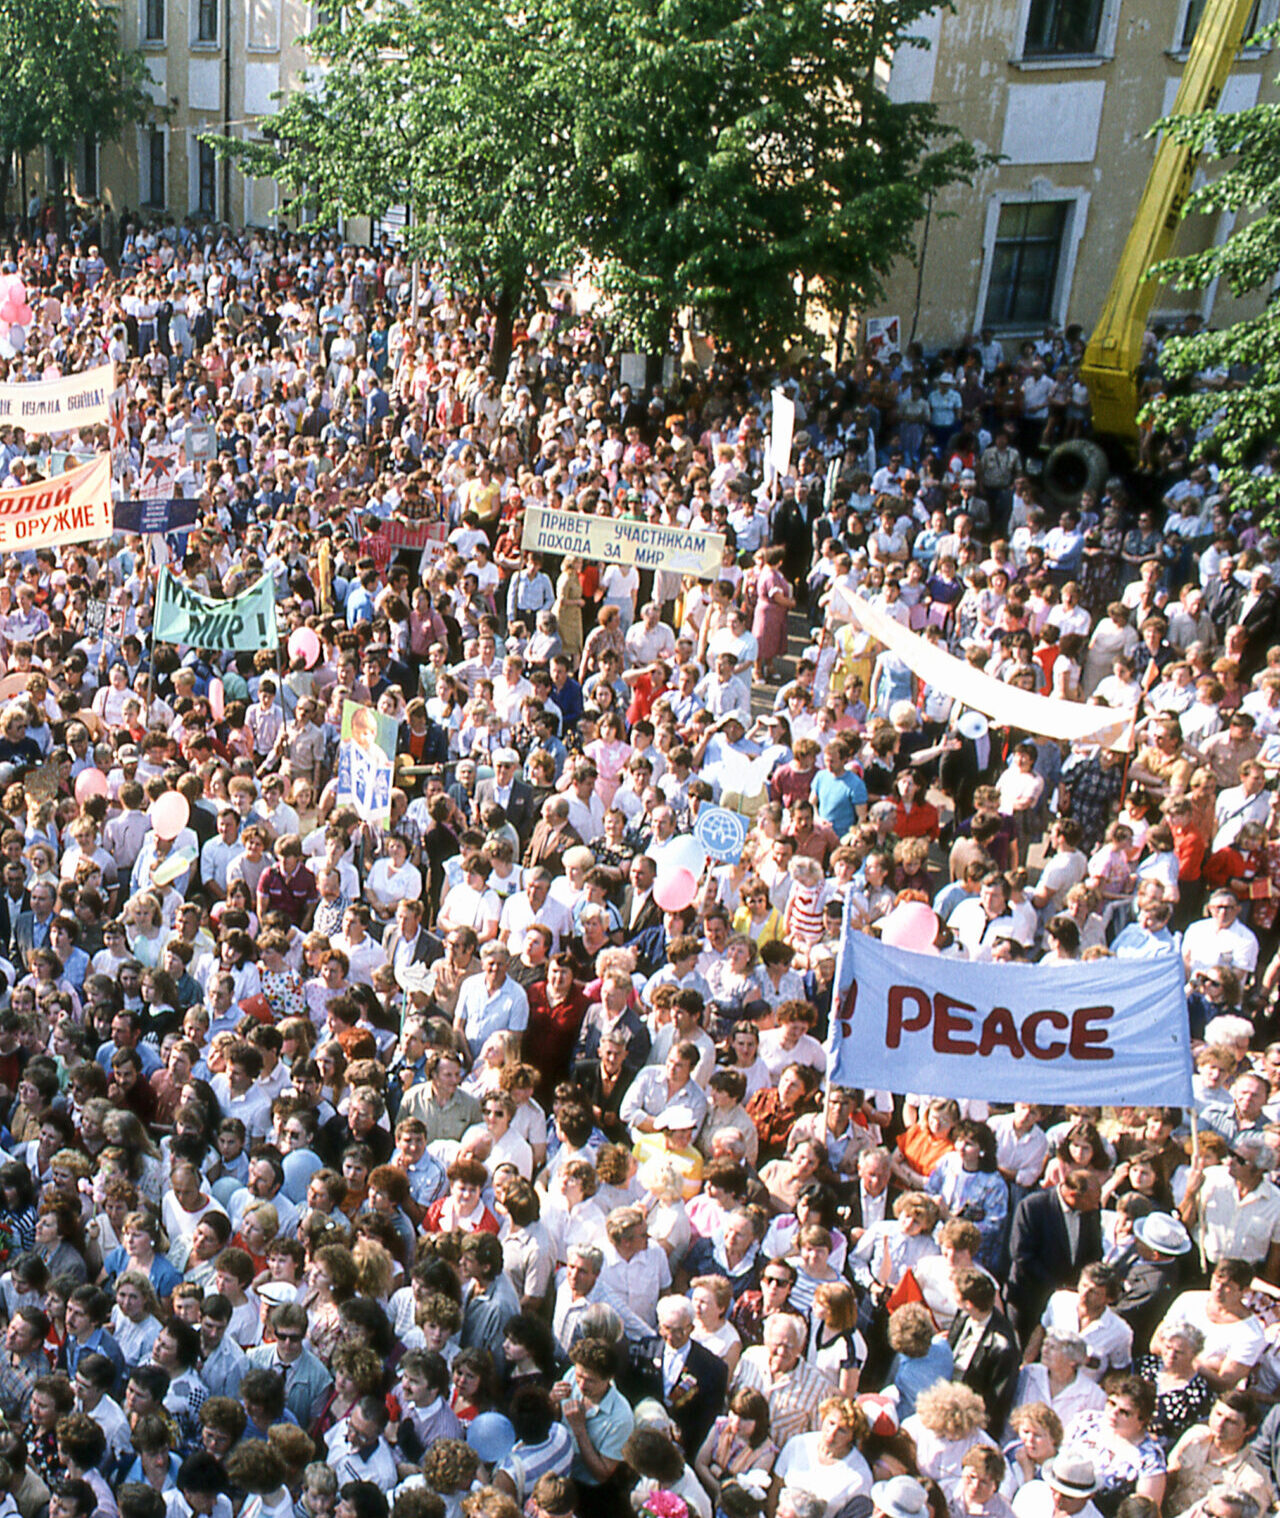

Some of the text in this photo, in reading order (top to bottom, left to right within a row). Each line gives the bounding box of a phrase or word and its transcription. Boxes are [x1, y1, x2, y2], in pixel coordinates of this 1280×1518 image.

[0, 398, 13, 416] НЕ
[22, 399, 61, 417] НУЖНА
[15, 504, 95, 539] ОРУЖИЕ
[540, 512, 707, 554] ПРИВЕТ УЧАСТНИКАМ
[537, 532, 665, 566] ПОХОДА ЗА МИР
[183, 613, 244, 649] МИР
[886, 984, 1115, 1061] PEACE
